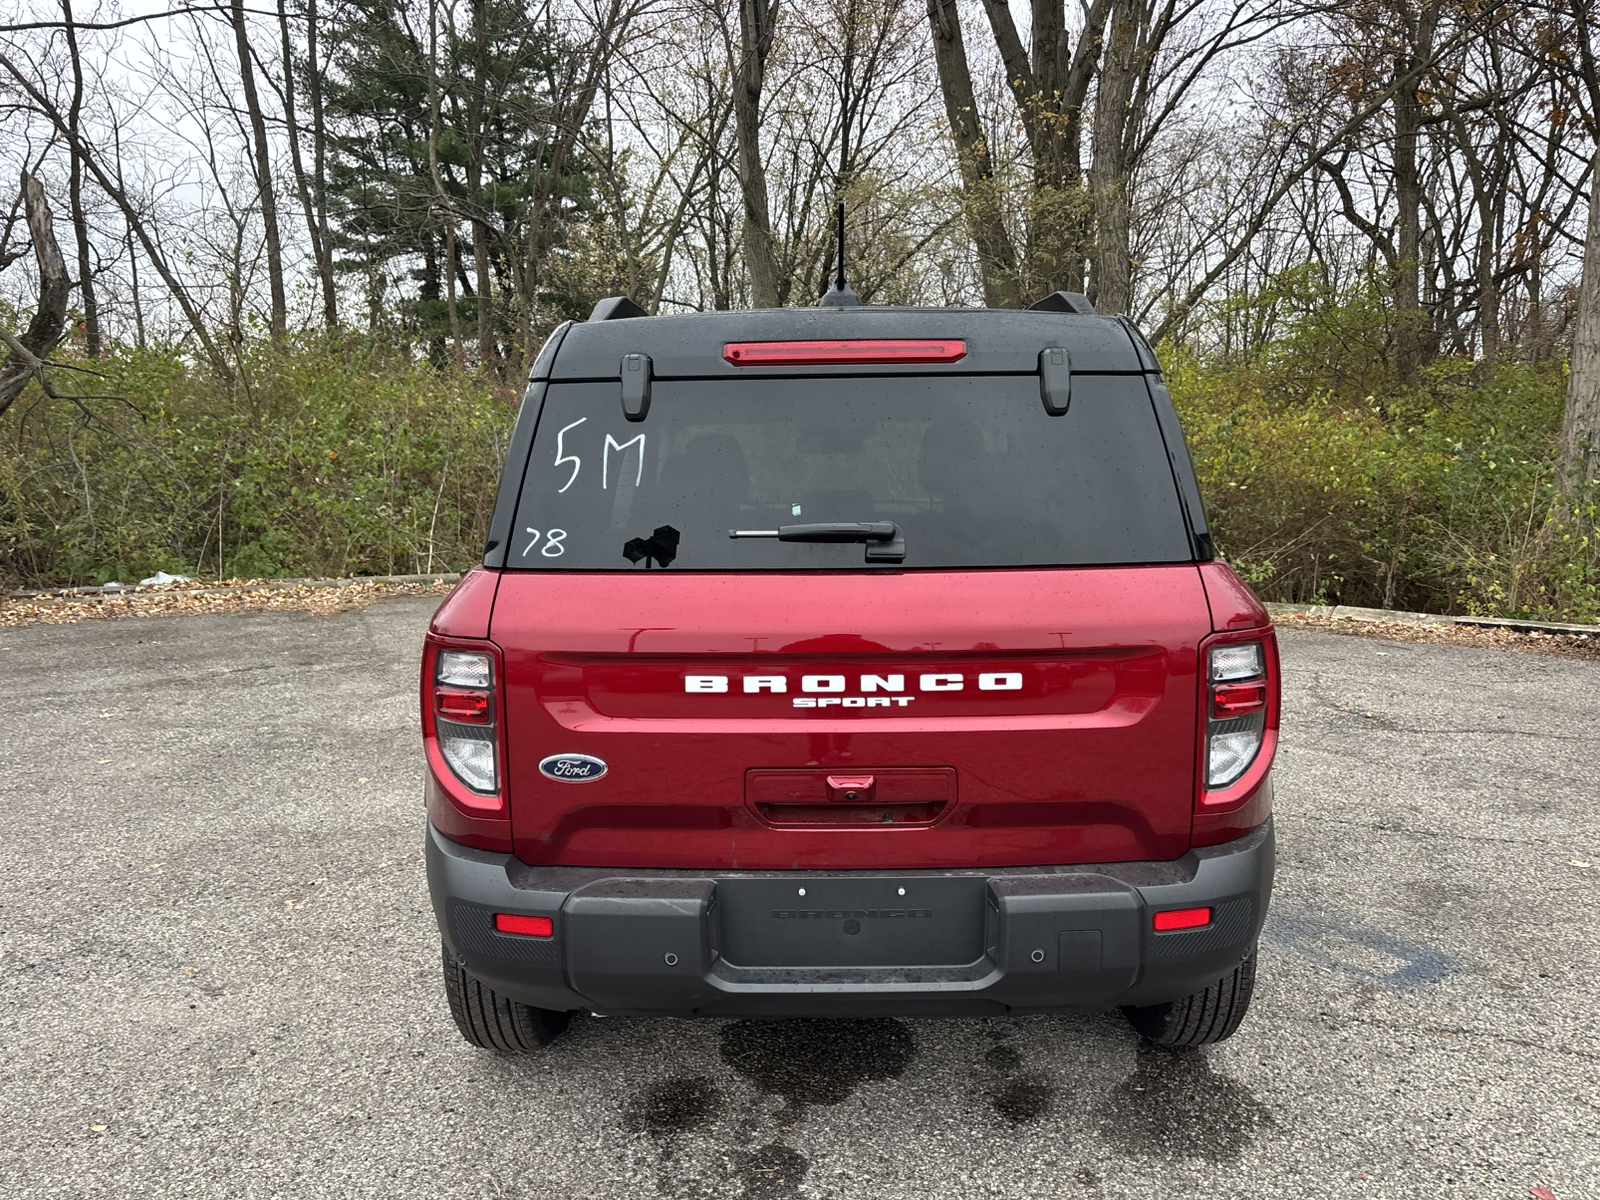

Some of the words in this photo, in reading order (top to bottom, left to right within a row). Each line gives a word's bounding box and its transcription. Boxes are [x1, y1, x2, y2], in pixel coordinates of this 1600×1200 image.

[521, 527, 568, 557] 78
[684, 672, 1023, 693] BRONCO
[792, 696, 915, 708] SPORT
[554, 759, 591, 776] Ford
[771, 909, 933, 919] BRONCO
